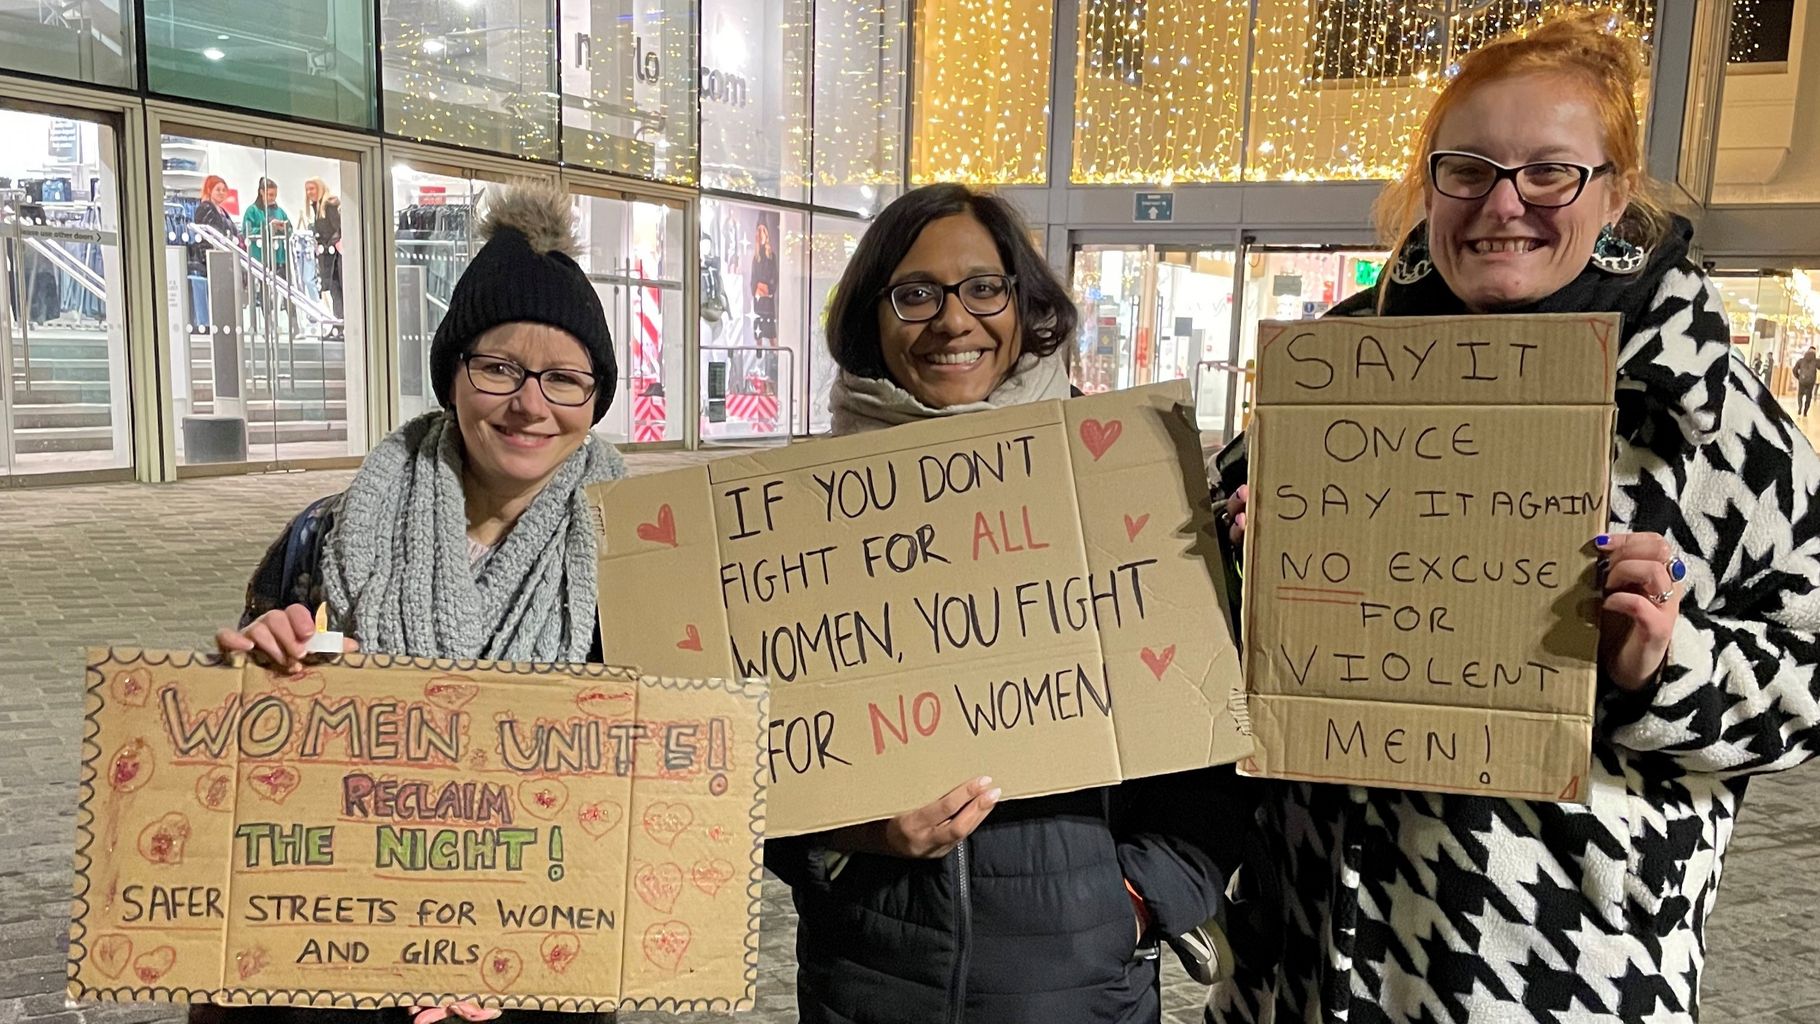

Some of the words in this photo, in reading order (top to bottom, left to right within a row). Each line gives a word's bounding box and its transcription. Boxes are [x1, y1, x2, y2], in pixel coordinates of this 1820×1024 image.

[1286, 332, 1438, 389] SAY
[1456, 341, 1538, 380] IT
[1324, 419, 1479, 462] ONCE
[725, 480, 784, 540] IF
[812, 460, 897, 522] YOU
[918, 435, 1036, 503] DON'T
[1276, 483, 1391, 520] SAY
[1414, 490, 1474, 517] IT
[1491, 490, 1604, 520] AGAIN
[719, 546, 838, 609] FIGHT
[862, 523, 952, 578] FOR
[972, 505, 1050, 561] ALL
[1281, 551, 1351, 583] NO
[1389, 551, 1559, 588] EXCUSE
[730, 601, 904, 682] WOMEN,
[913, 586, 1000, 654] YOU
[1015, 558, 1158, 638] FIGHT
[1360, 601, 1454, 633] FOR
[1280, 644, 1559, 692] VIOLENT
[160, 686, 460, 763] WOMEN
[499, 718, 729, 797] UNITE!
[767, 710, 853, 784] FOR
[867, 691, 942, 756] NO
[953, 662, 1112, 737] WOMEN
[1325, 718, 1491, 785] MEN!
[341, 772, 514, 825] RECLAIM
[234, 822, 335, 867] THE
[375, 825, 565, 882] NIGHT!
[121, 885, 224, 923] SAFER
[245, 895, 398, 924] STREETS
[497, 898, 615, 930] WOMEN
[295, 938, 370, 964] AND
[401, 938, 480, 965] GIRLS
